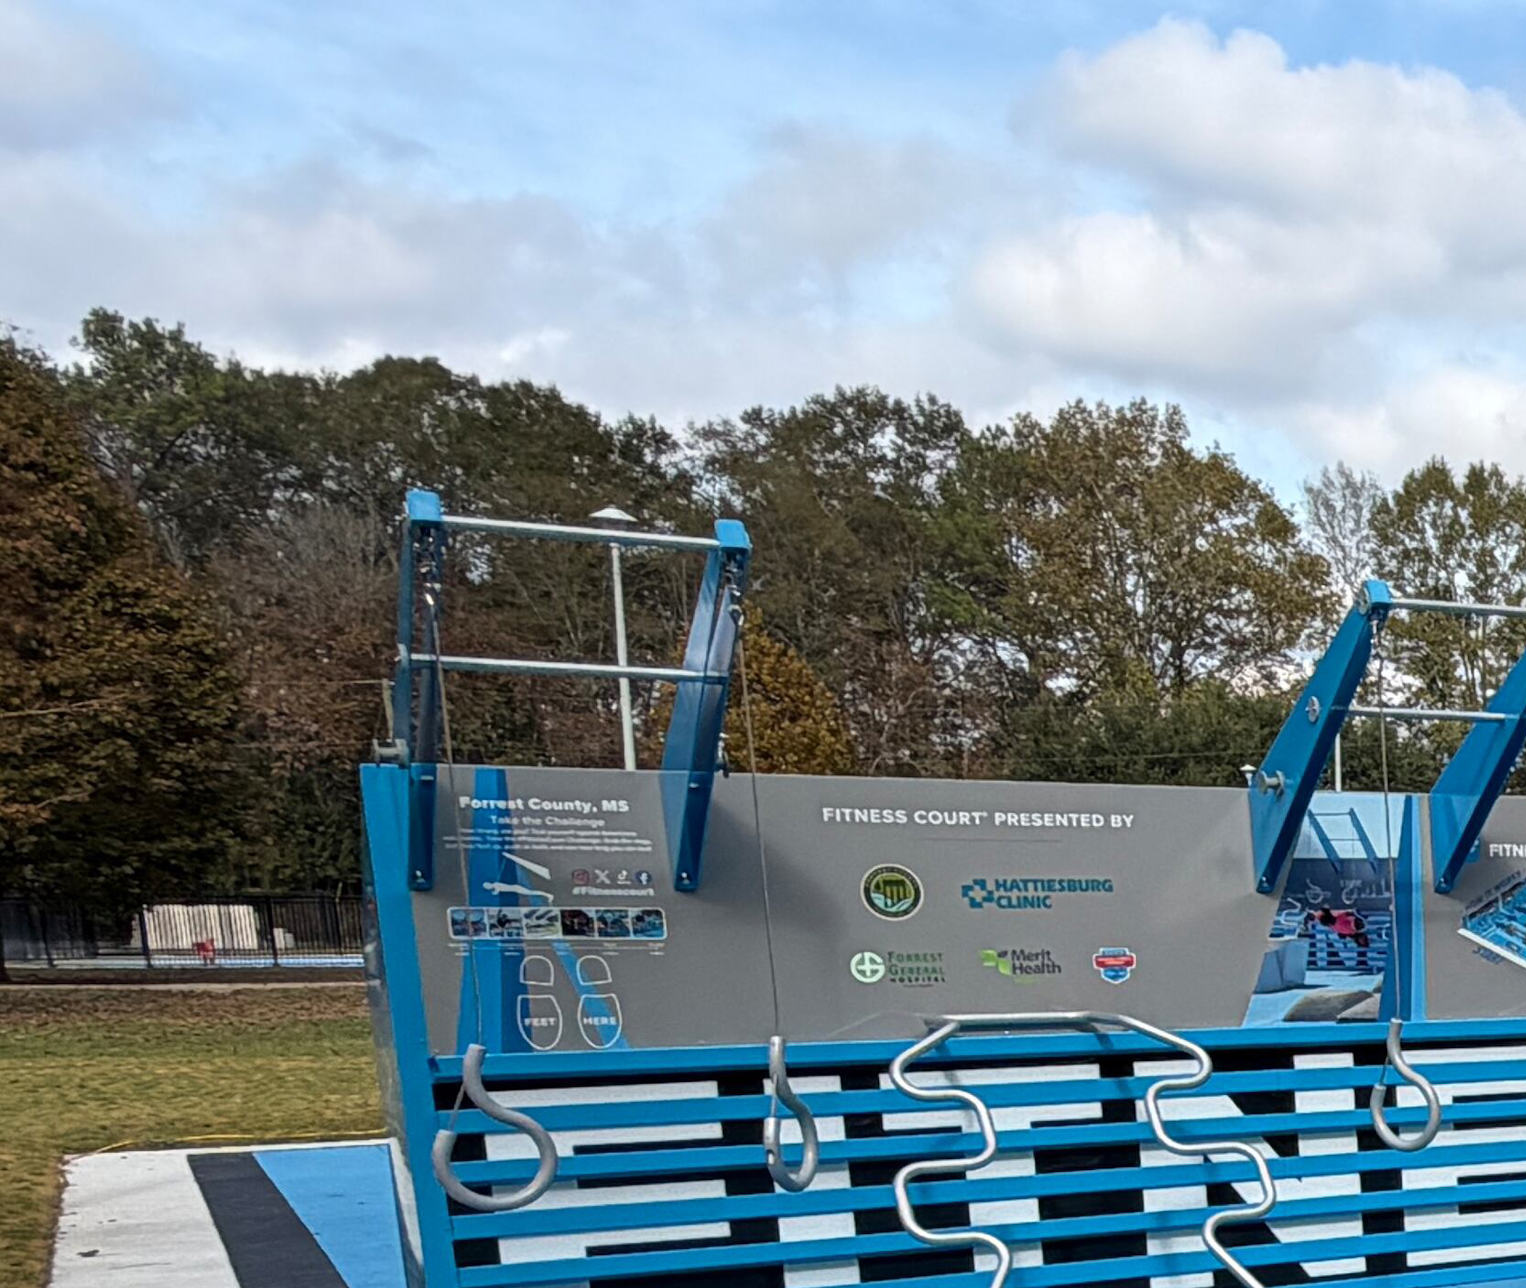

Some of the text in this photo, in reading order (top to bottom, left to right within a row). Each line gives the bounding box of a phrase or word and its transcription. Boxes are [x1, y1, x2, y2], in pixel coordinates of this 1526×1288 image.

[459, 796, 630, 815] Forrest County, MS
[490, 815, 605, 829] Take the Challenge
[822, 807, 908, 824] FITNESS
[994, 811, 1105, 827] PRESENTED
[1110, 813, 1134, 828] BY
[995, 878, 1114, 893] HATTIESBURG
[996, 893, 1053, 909] CLINIC
[888, 951, 945, 963] FORREST
[1011, 949, 1052, 962] Merit
[888, 963, 945, 976] GENERAL
[1012, 961, 1062, 975] Health
[889, 975, 946, 983] HOSPITAL
[524, 1017, 557, 1027] FEET
[583, 1016, 617, 1026] HERE
